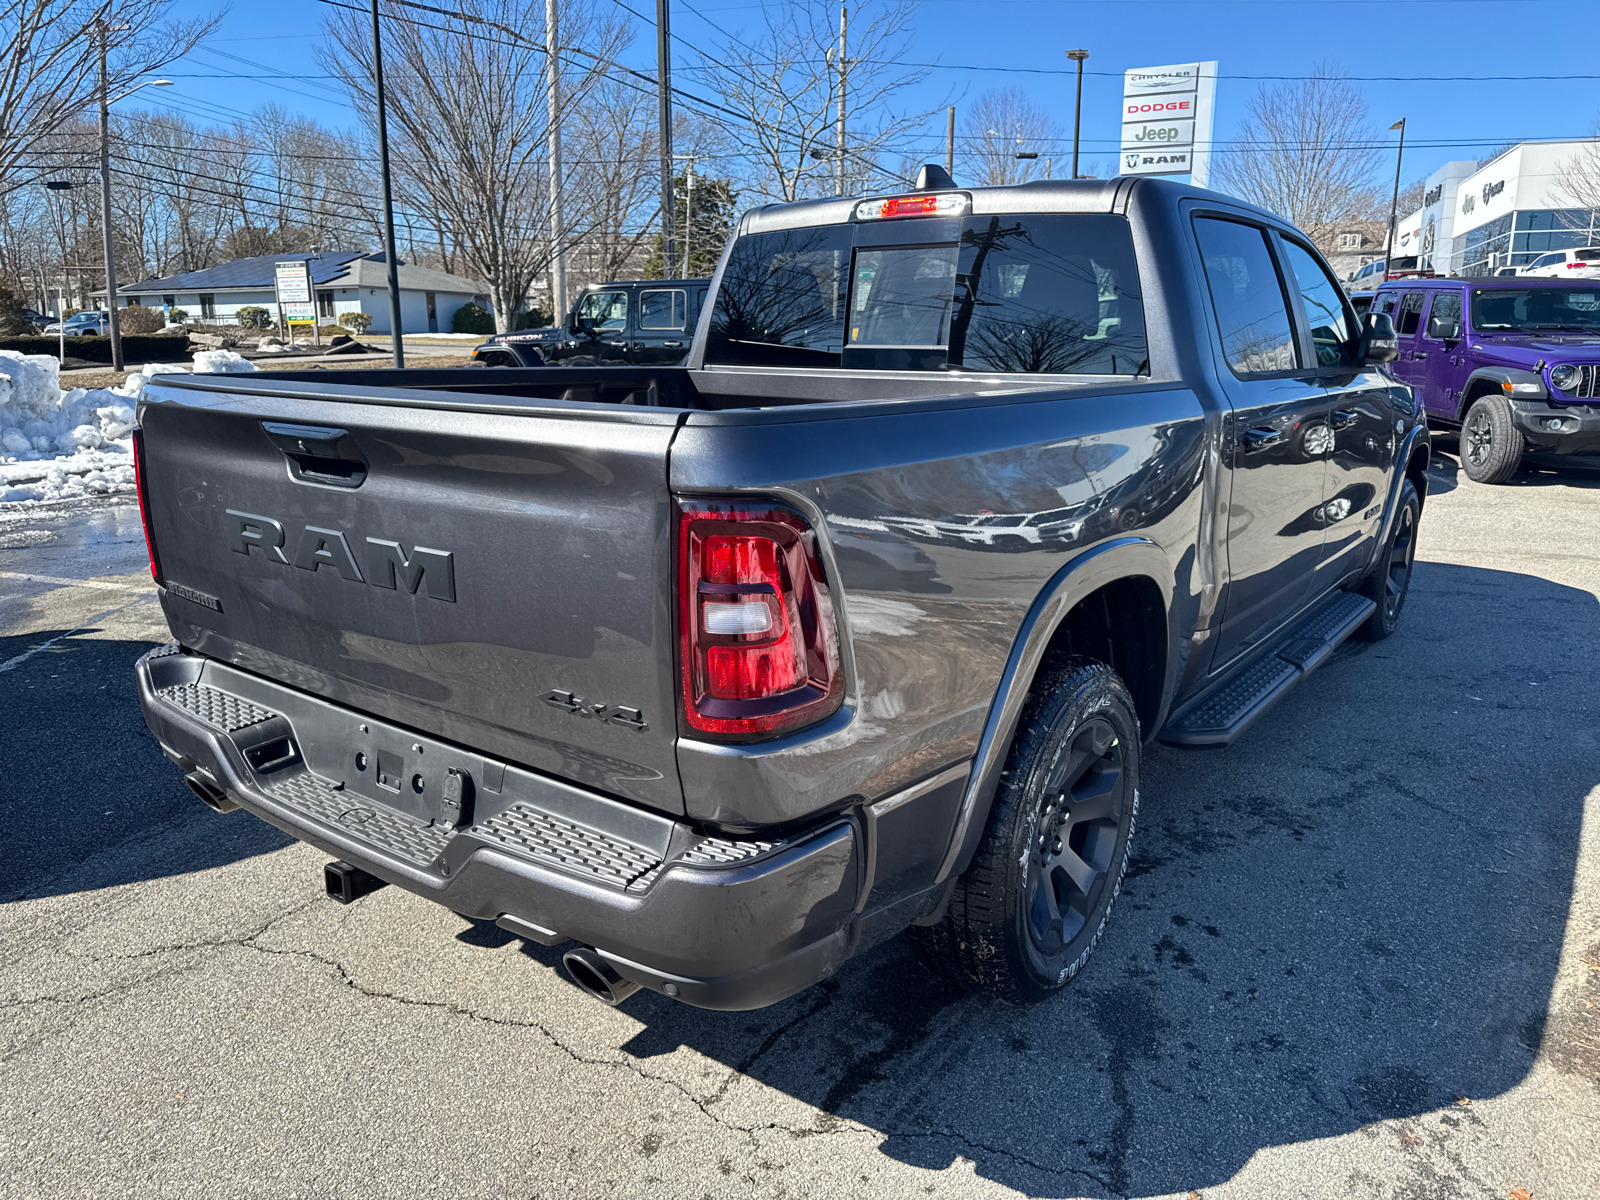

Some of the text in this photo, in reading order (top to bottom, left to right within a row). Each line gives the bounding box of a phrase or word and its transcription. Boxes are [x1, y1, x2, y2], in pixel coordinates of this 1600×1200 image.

[1131, 71, 1190, 81] CHRYSLER
[1127, 101, 1190, 114] DODGE
[1135, 126, 1179, 142] Jeep
[1142, 155, 1186, 165] RAM
[494, 334, 543, 342] RUBICON
[225, 508, 457, 604] RAM
[1057, 787, 1141, 984] BRIDGESTONE
